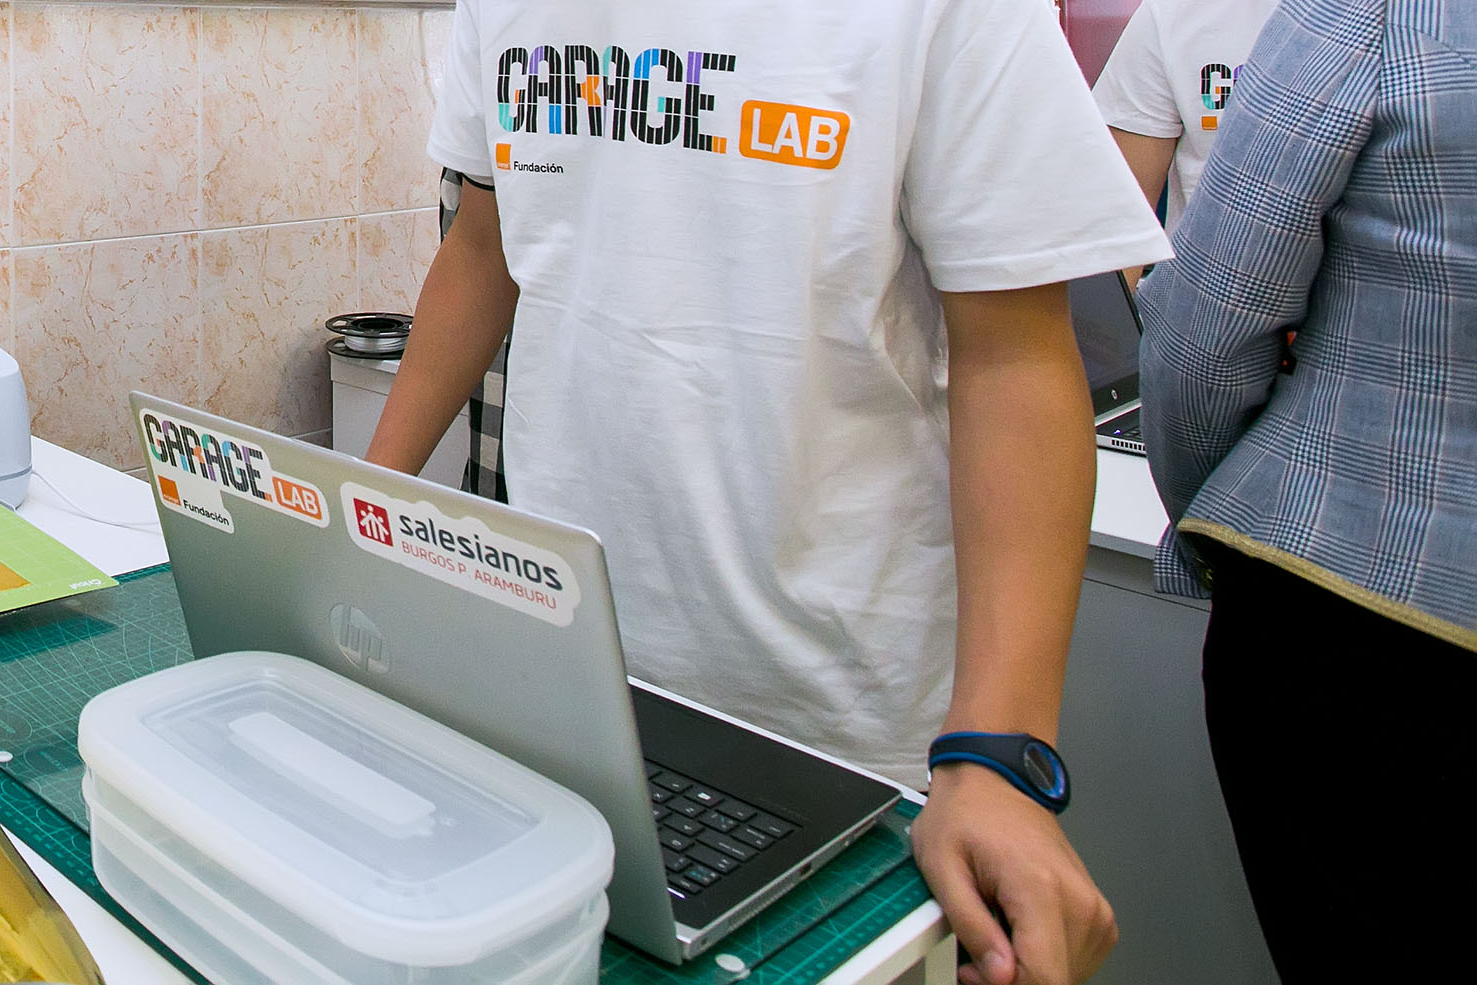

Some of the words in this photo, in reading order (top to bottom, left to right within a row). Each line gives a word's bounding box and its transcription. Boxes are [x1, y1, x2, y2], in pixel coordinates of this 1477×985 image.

[497, 44, 737, 154] GARAGE
[750, 107, 841, 161] LAB
[513, 161, 564, 173] Fundación
[143, 414, 273, 503] GARAGE
[277, 481, 318, 515] LAB
[182, 499, 230, 526] Fundación
[399, 514, 563, 591] salesianos
[401, 540, 455, 572] BURGOS
[474, 569, 557, 610] ARAMBURU
